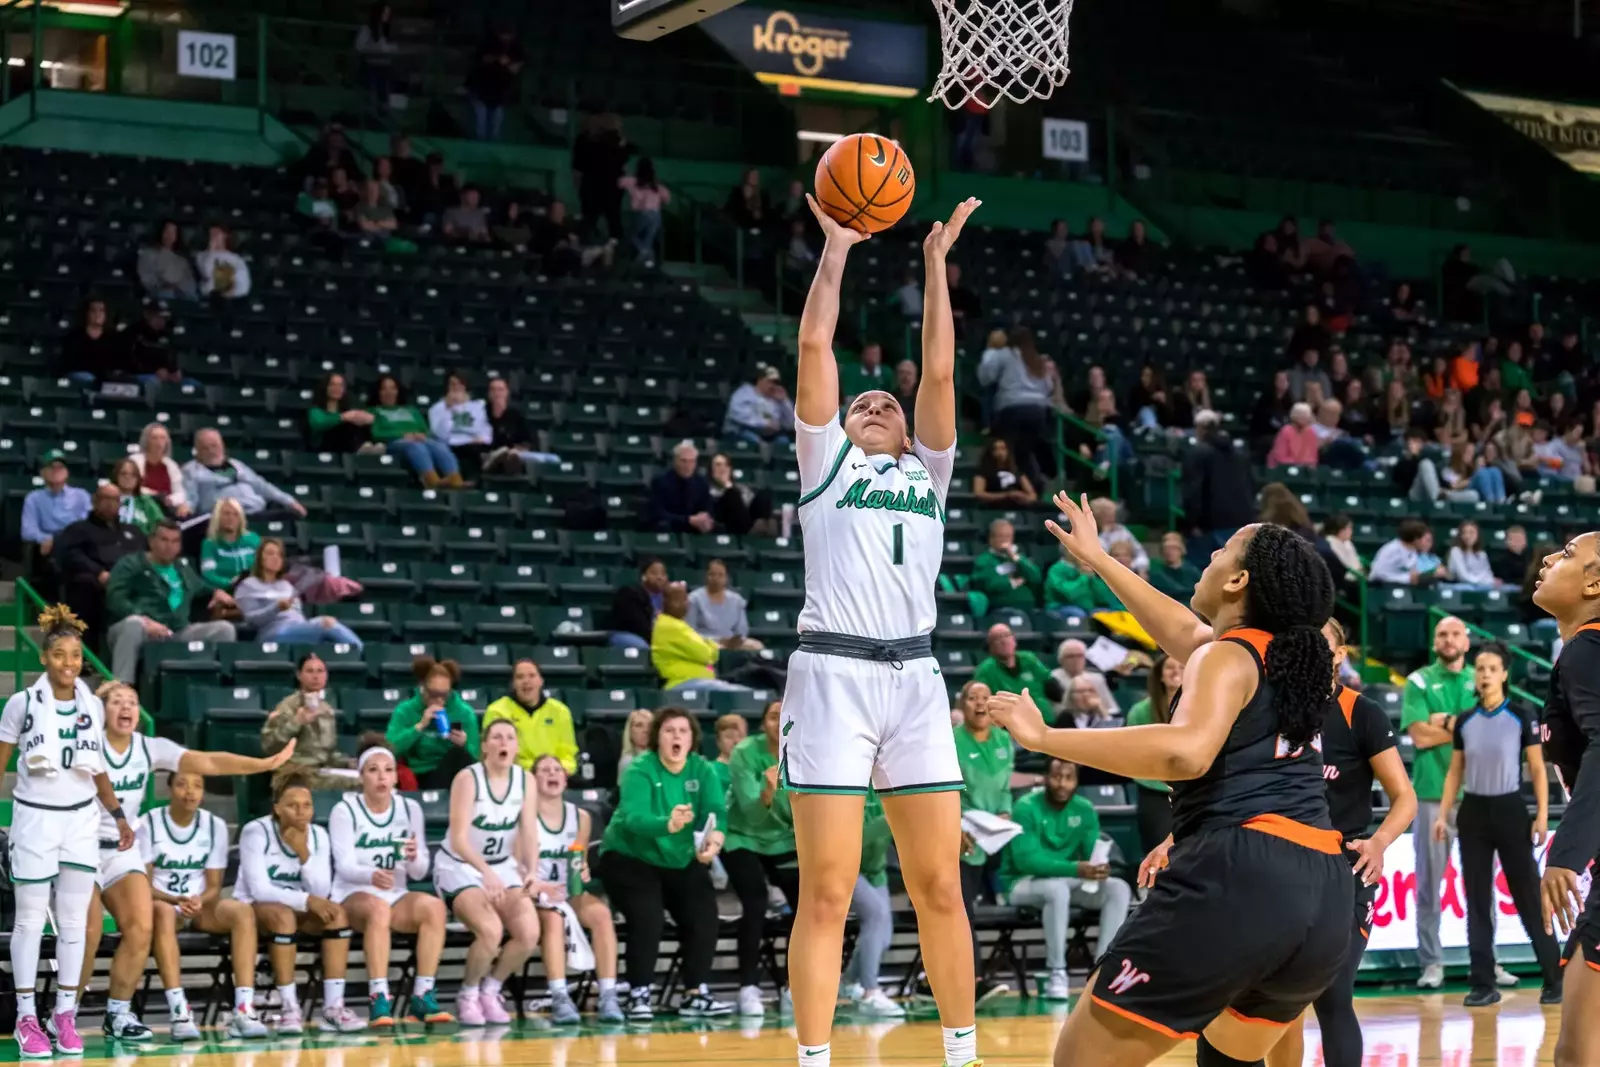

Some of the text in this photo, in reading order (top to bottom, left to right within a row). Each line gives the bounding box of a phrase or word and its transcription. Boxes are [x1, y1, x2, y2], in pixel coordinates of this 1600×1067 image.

[186, 41, 229, 69] 102
[753, 10, 852, 76] Kroger
[1050, 127, 1082, 153] 103
[892, 522, 904, 566] 1
[62, 746, 74, 770] 0
[483, 836, 504, 856] 21
[166, 872, 190, 894] 22
